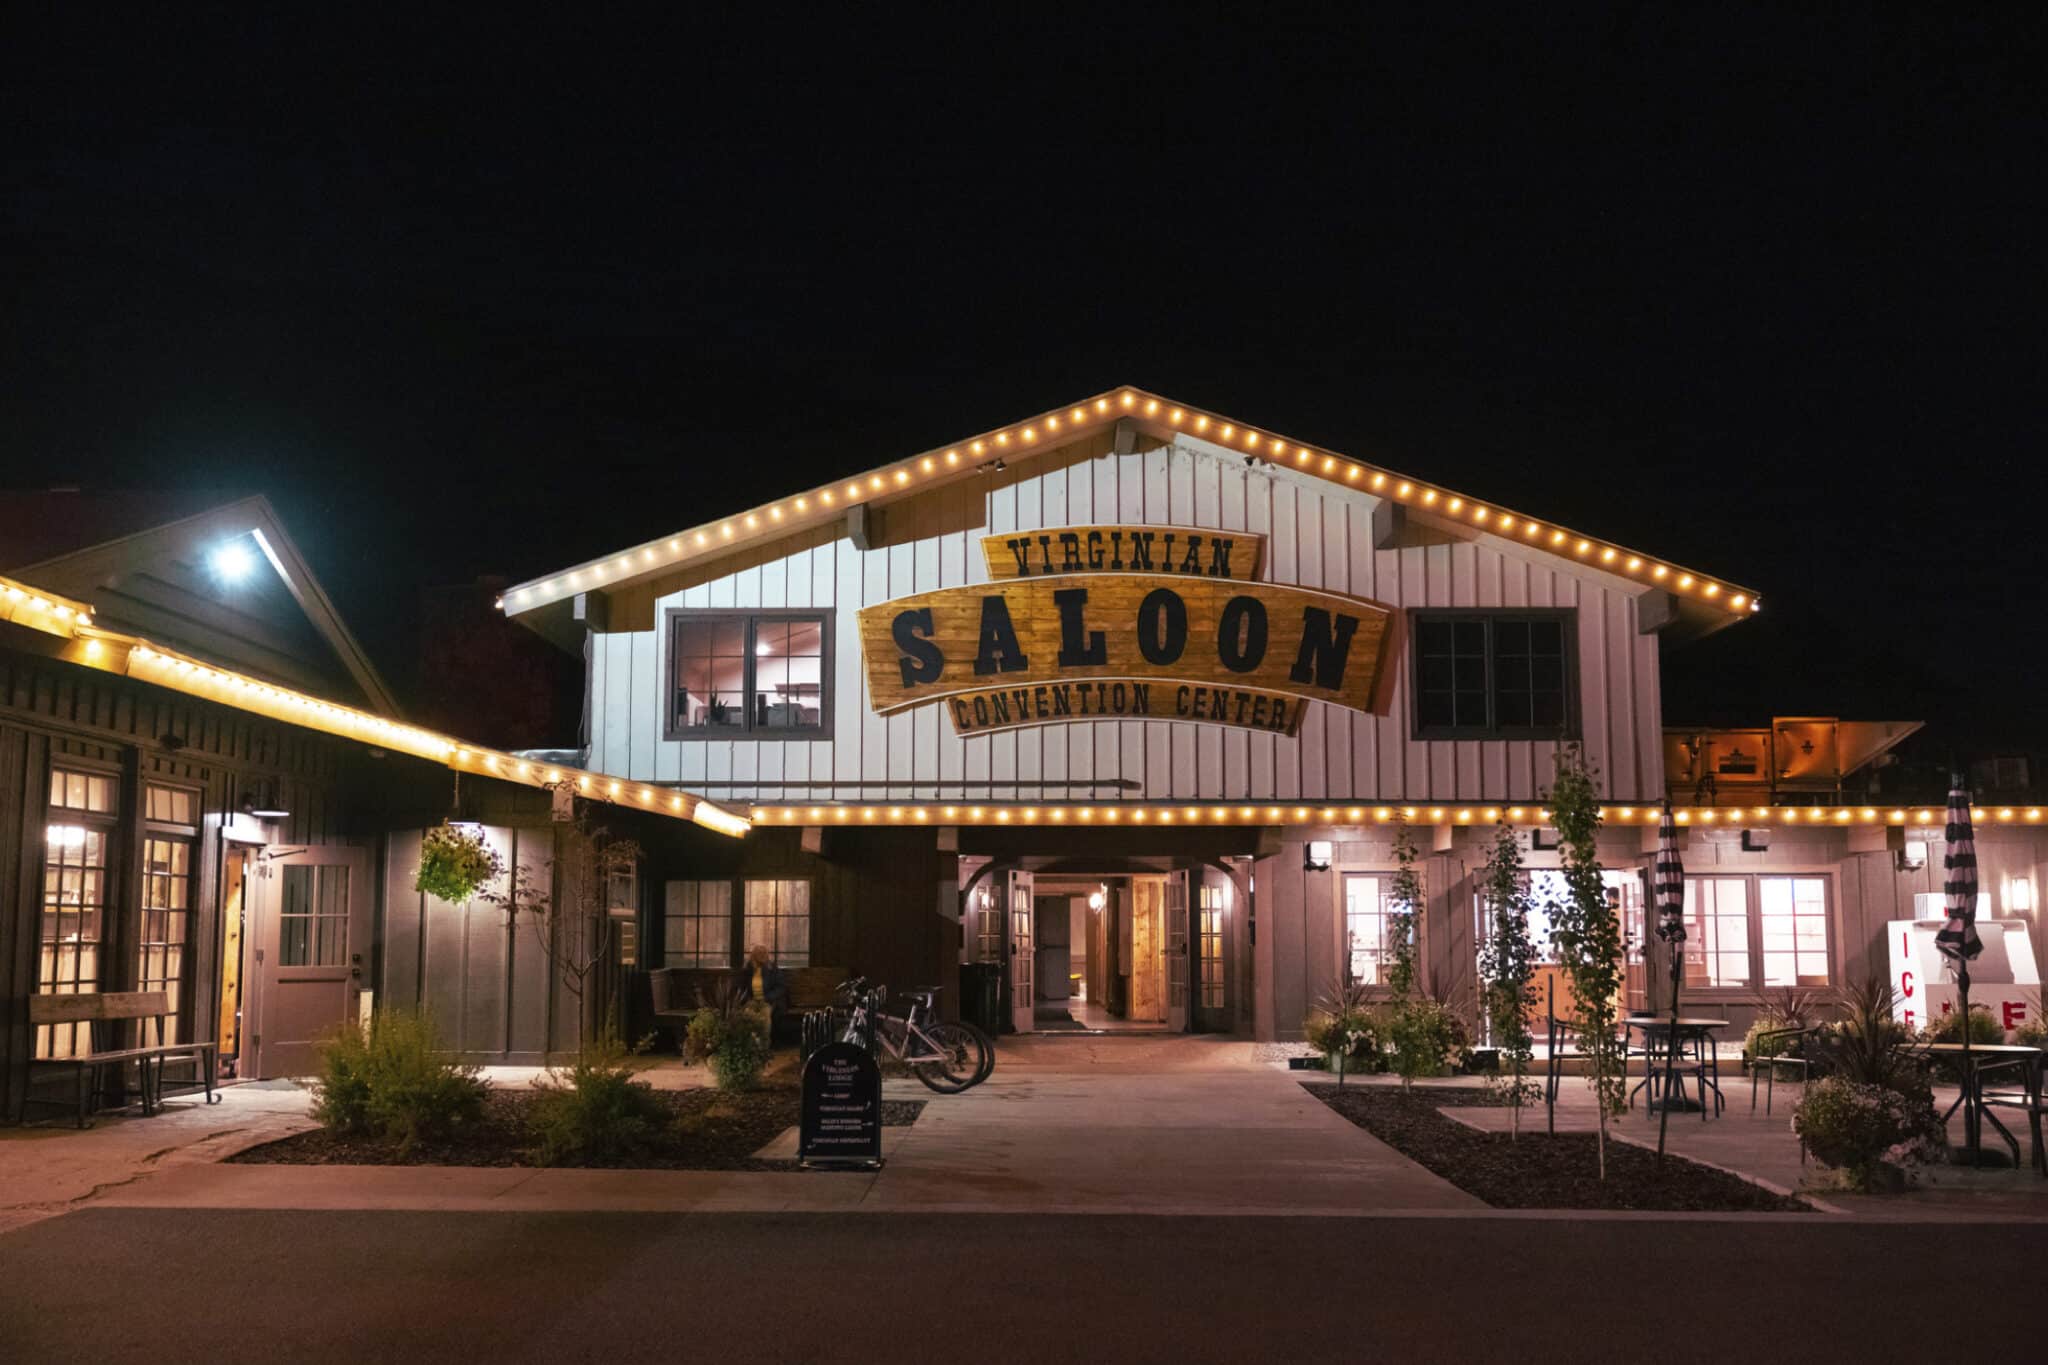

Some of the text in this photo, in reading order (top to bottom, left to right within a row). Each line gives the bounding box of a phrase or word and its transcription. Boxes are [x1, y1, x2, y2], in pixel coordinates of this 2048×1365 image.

[1007, 533, 1233, 575] VIRGINIAN
[892, 588, 1358, 691] SALOON
[955, 682, 1288, 730] CONVENTION CENTER
